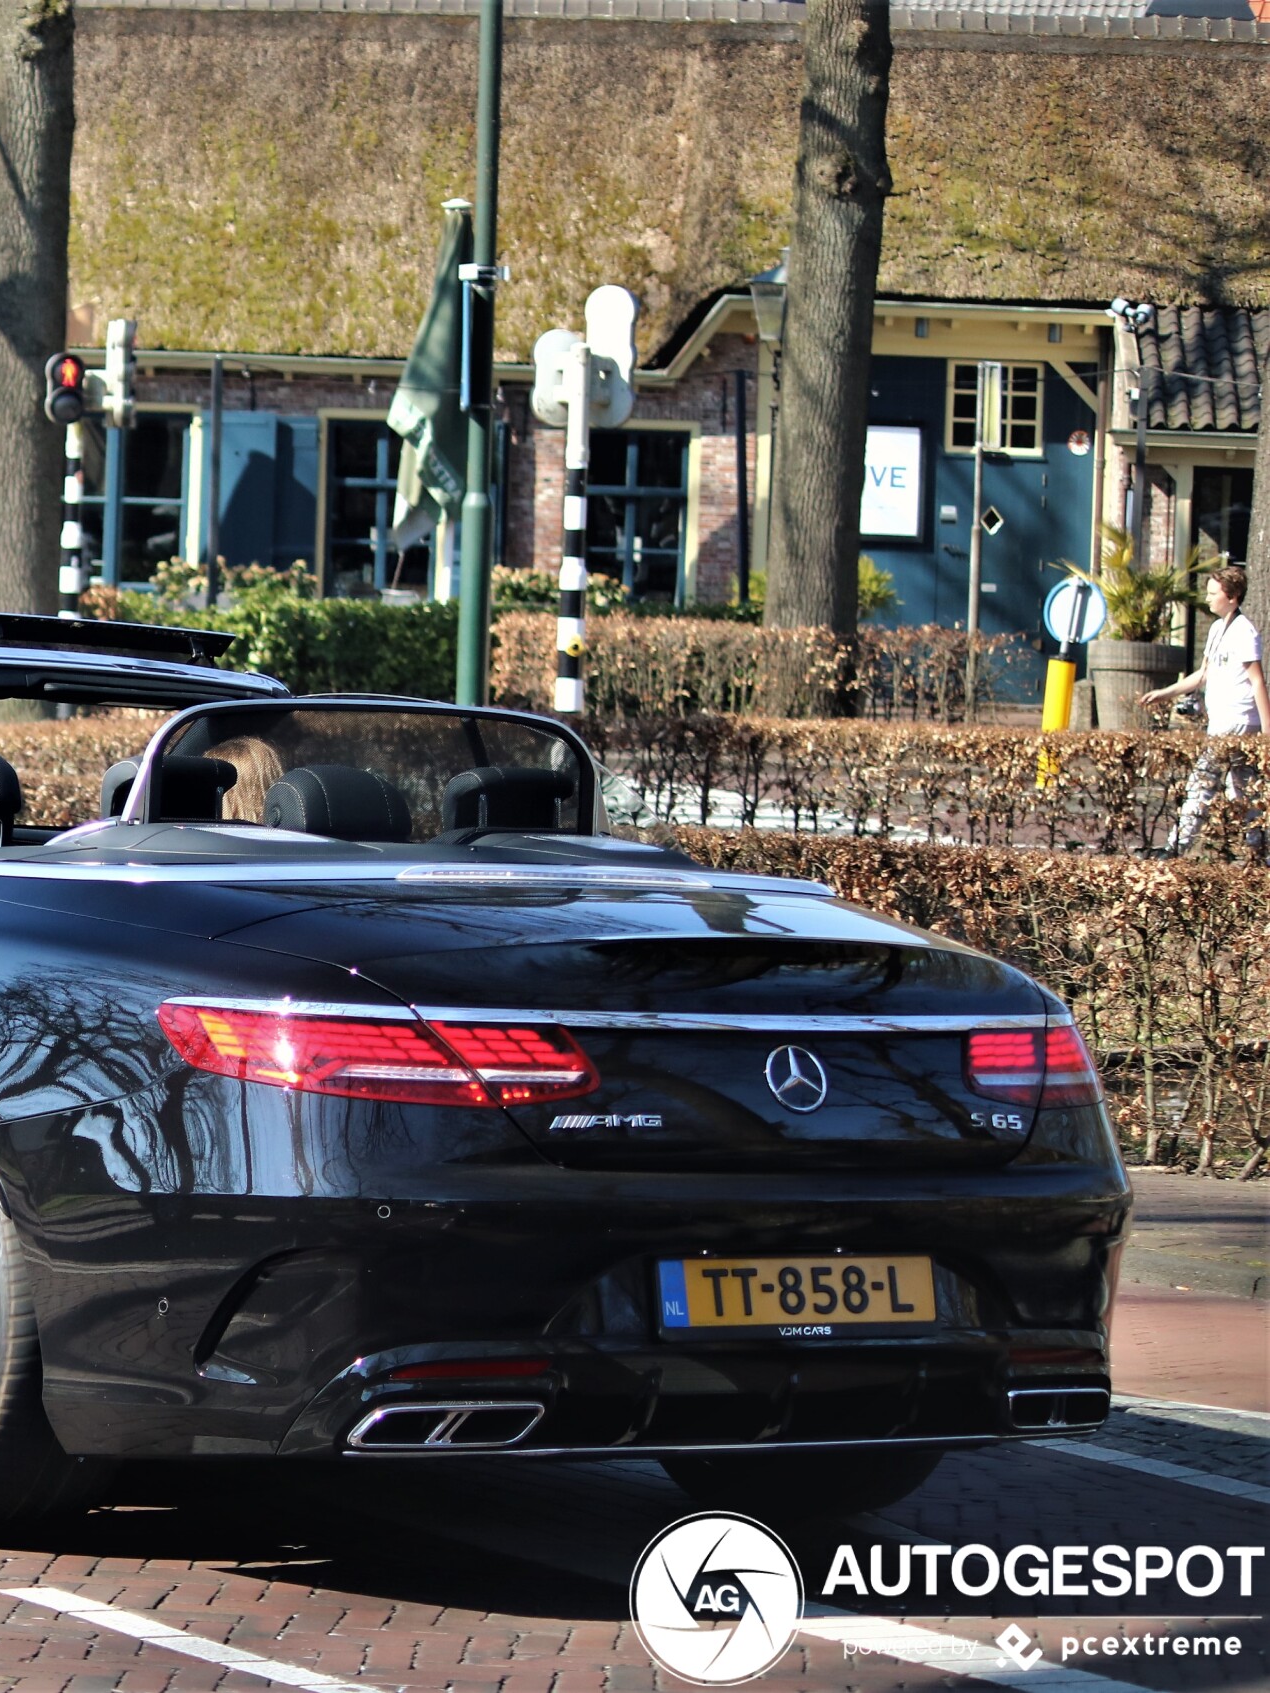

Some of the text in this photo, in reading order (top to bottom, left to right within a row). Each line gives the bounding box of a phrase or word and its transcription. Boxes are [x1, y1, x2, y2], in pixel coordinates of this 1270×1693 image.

[586, 1113, 662, 1129] AMG
[970, 1112, 1023, 1130] S 65
[702, 1265, 915, 1317] TT-858-L
[665, 1301, 685, 1316] NL
[803, 1326, 832, 1336] CARS
